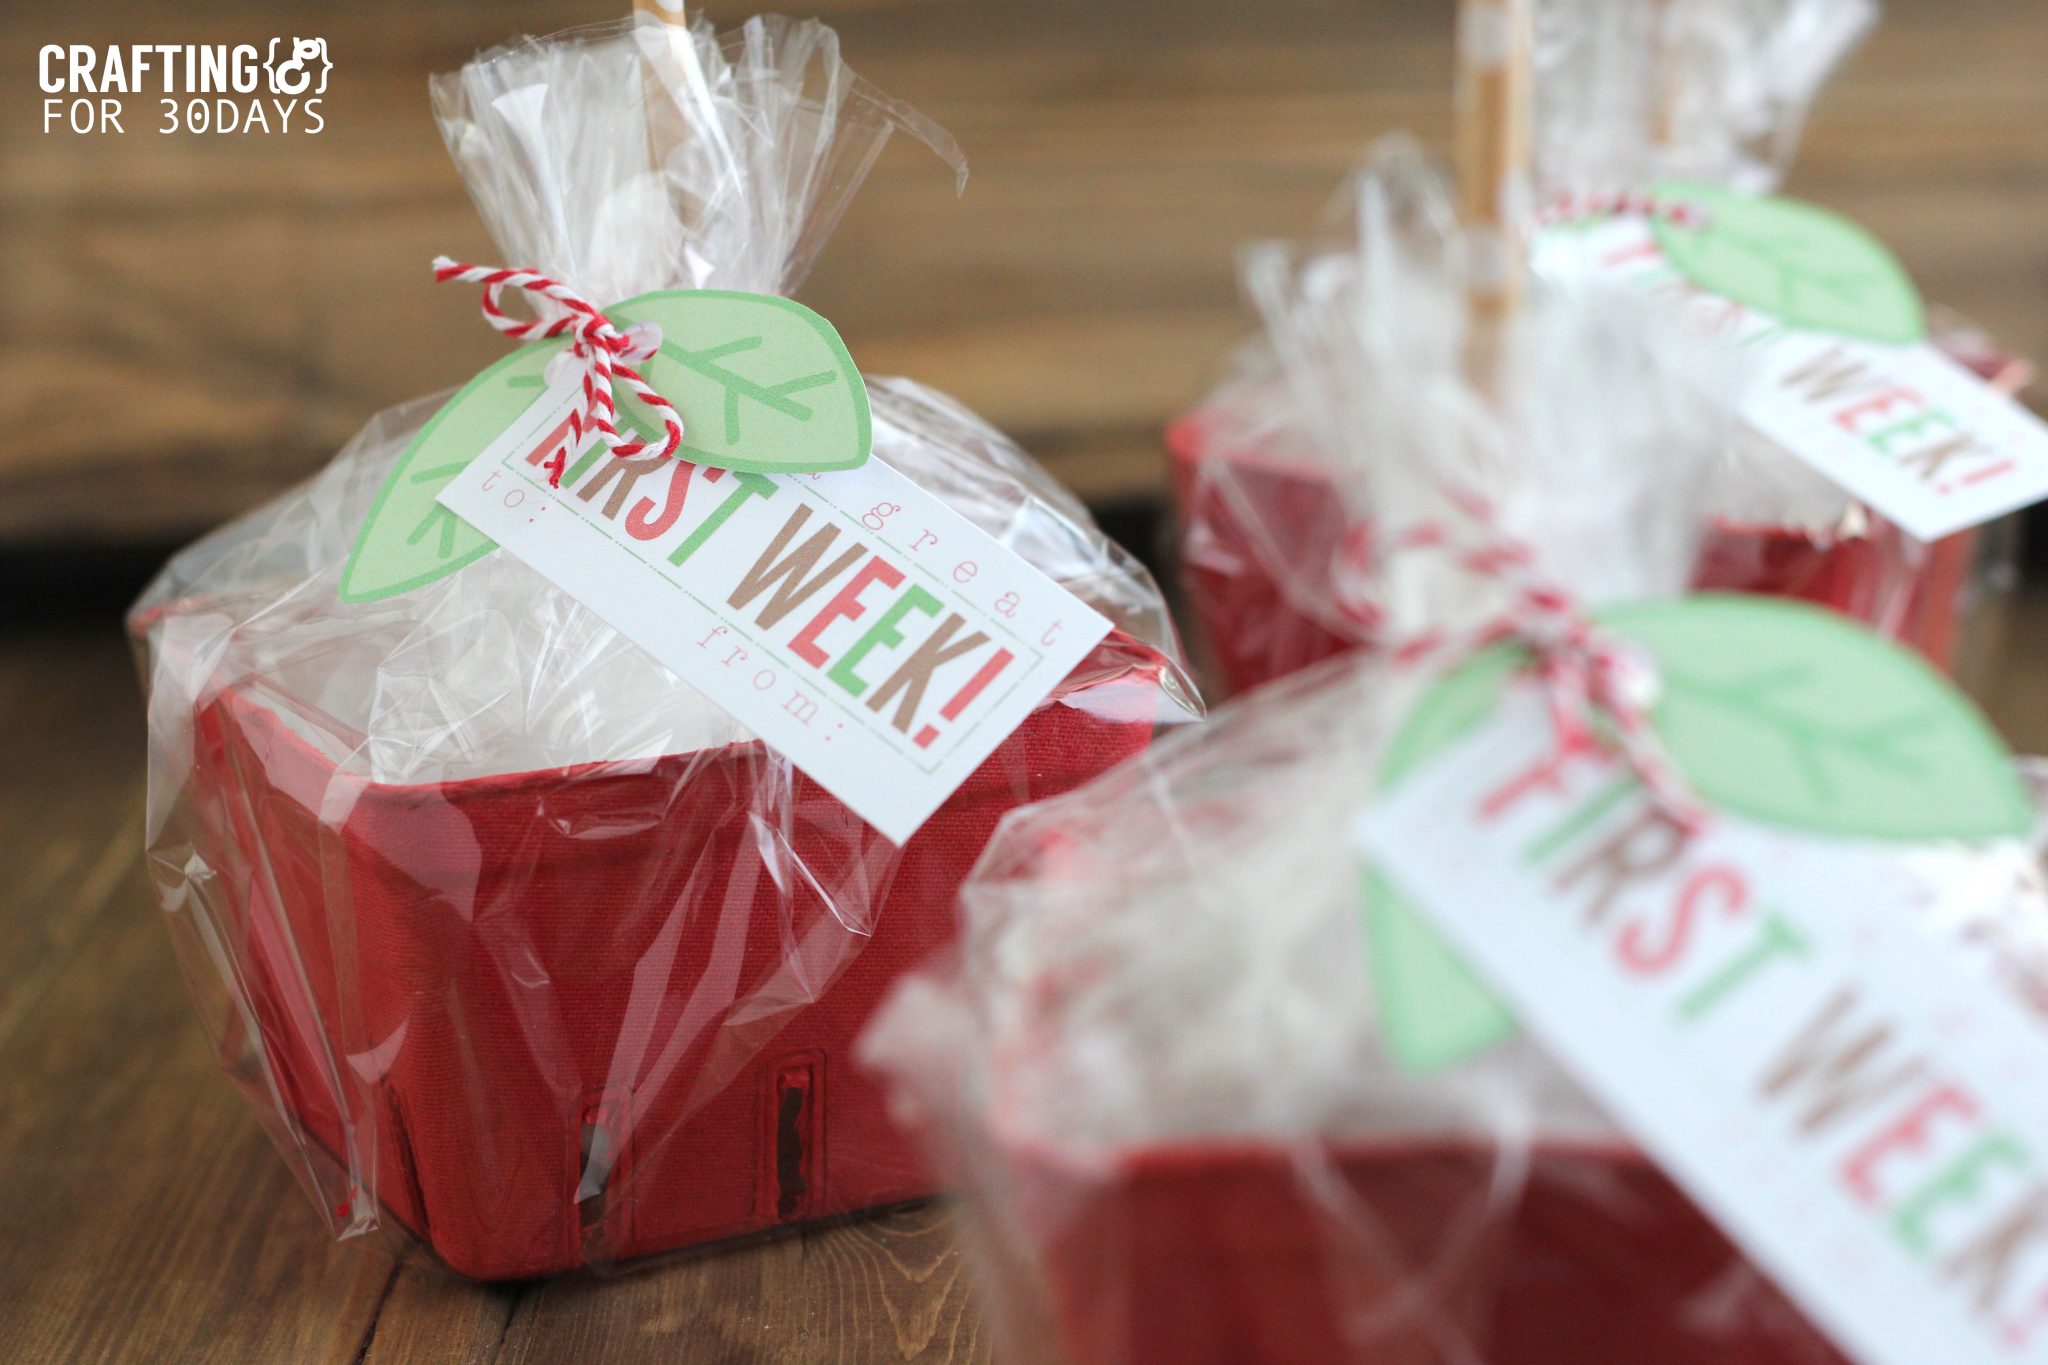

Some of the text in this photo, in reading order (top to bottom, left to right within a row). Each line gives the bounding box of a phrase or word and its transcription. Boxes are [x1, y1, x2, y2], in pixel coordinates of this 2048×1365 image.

[1777, 344, 2017, 496] WEEK!
[480, 469, 845, 742] to: from:
[725, 502, 1016, 751] WEEK!
[861, 501, 1064, 647] great
